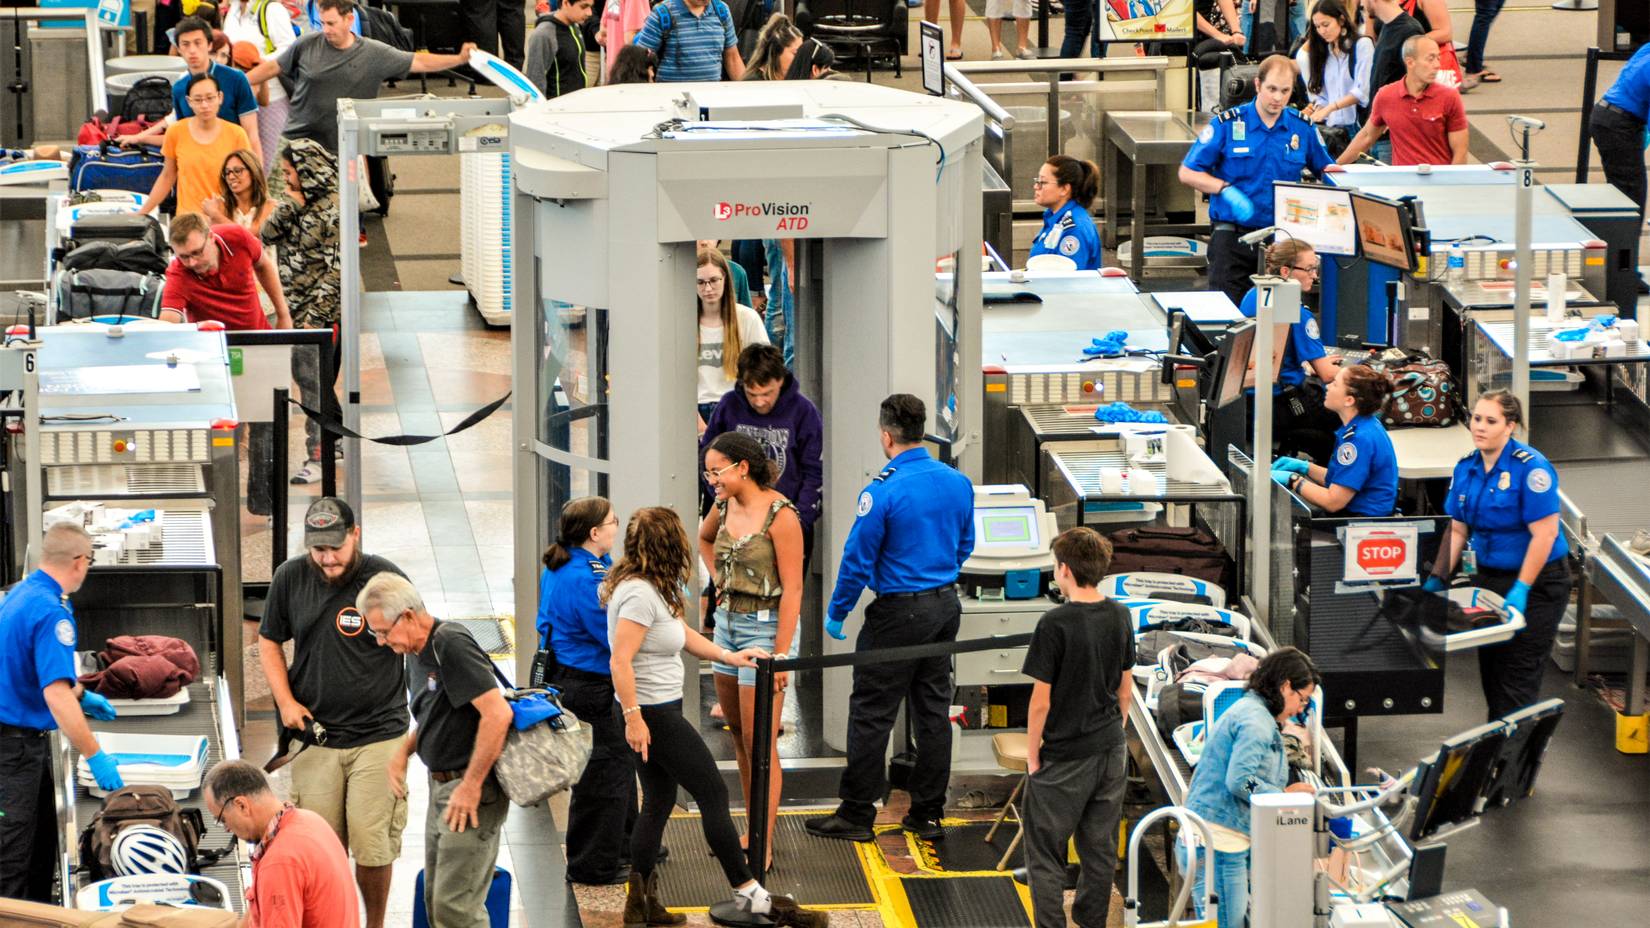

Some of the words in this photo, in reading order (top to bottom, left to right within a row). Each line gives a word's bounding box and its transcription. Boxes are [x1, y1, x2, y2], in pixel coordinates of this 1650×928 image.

[1524, 169, 1532, 187] 8
[735, 202, 809, 217] ProVision
[776, 217, 809, 231] ATD
[1263, 287, 1272, 306] 7
[26, 352, 34, 373] 6
[1362, 546, 1402, 560] STOP
[339, 615, 362, 628] IES
[1276, 815, 1309, 826] iLane
